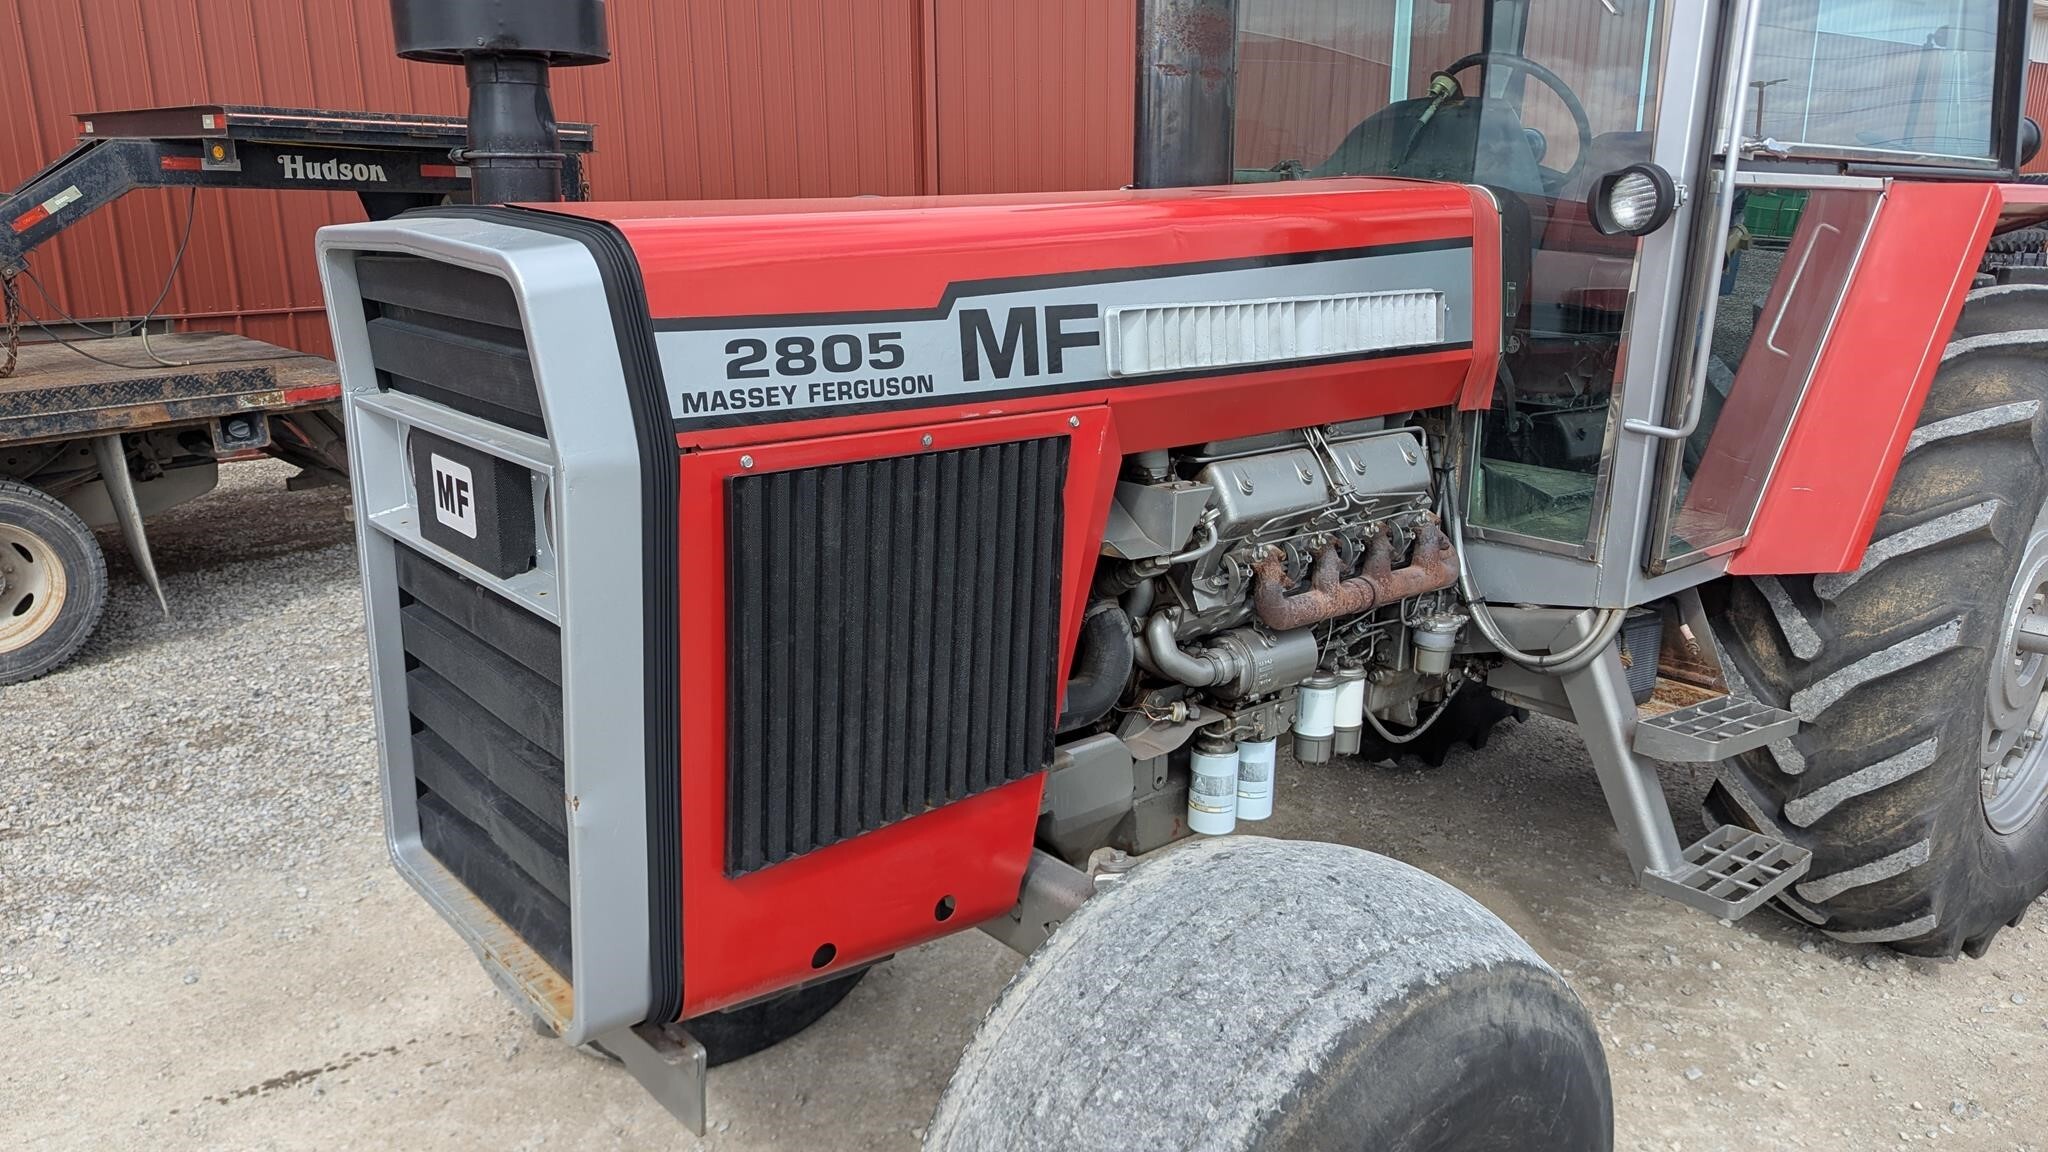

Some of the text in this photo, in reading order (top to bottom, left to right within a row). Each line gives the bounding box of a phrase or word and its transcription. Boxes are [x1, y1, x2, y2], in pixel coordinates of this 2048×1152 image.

[277, 154, 388, 182] Hudson
[724, 331, 905, 380] 2805
[959, 303, 1101, 382] MF
[681, 374, 934, 414] MASSEY FERGUSON
[436, 469, 469, 519] MF
